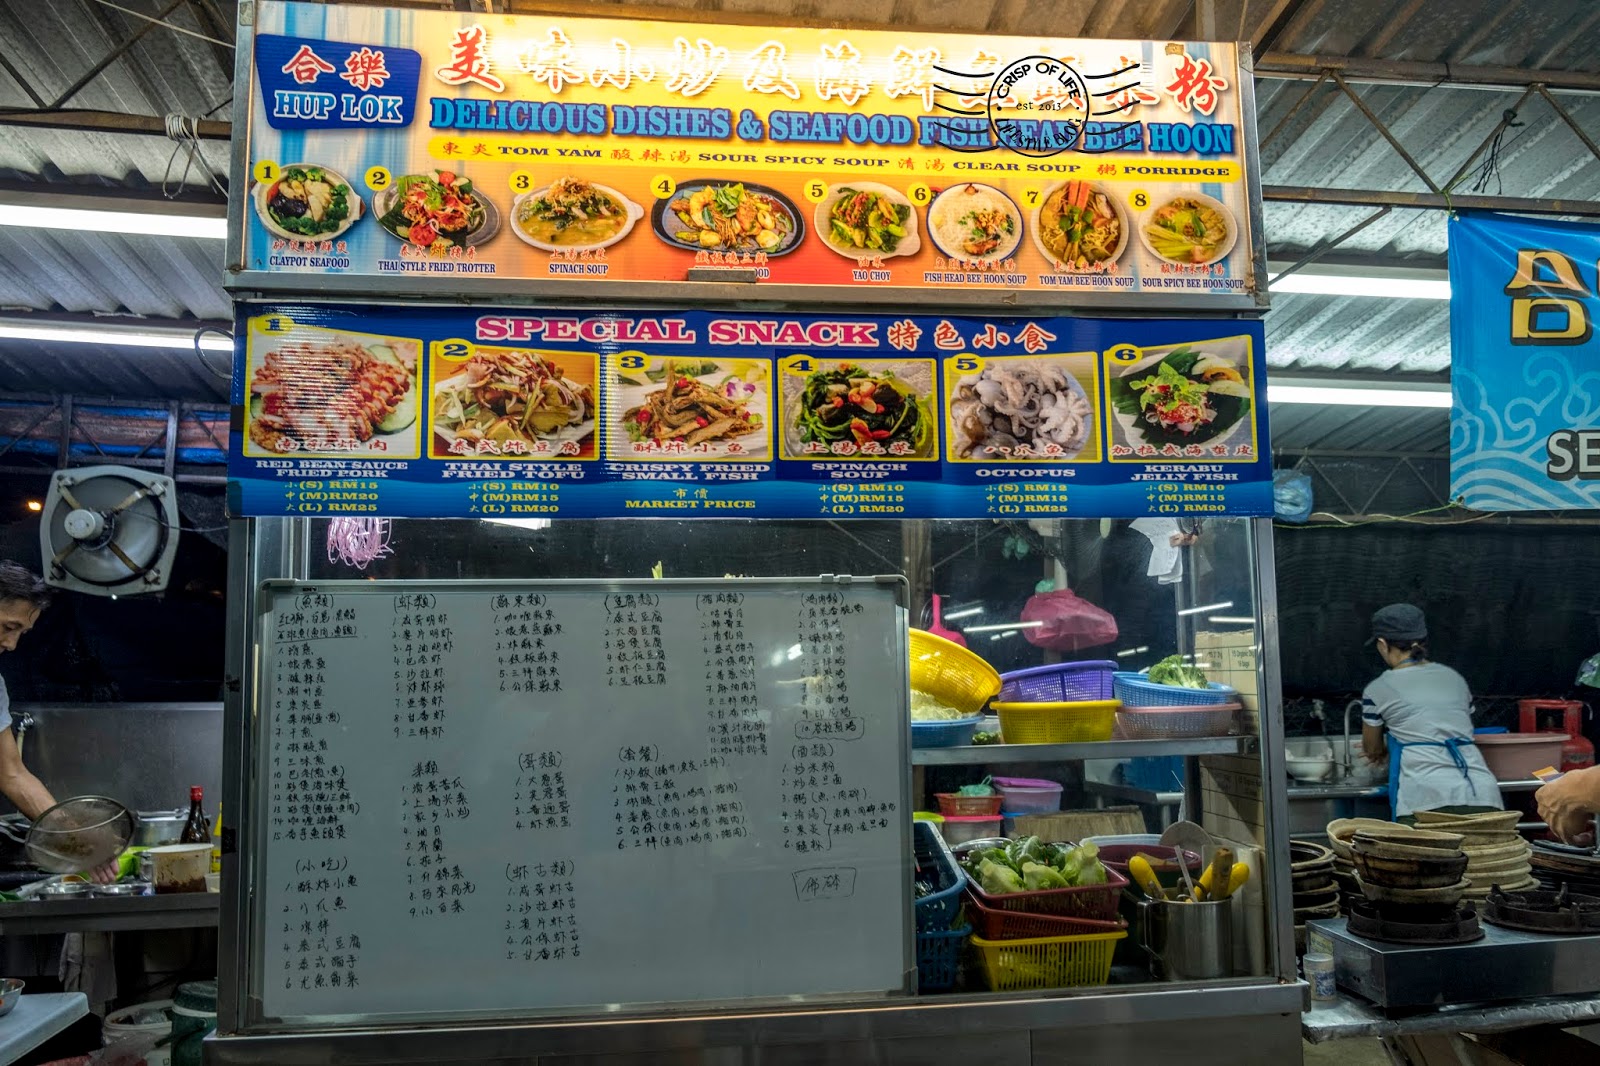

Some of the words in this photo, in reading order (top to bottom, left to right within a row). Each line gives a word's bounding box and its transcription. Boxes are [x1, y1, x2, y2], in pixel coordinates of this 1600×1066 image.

[283, 45, 391, 90] 合樂
[274, 91, 335, 119] HUP
[340, 94, 403, 123] LOK
[430, 97, 606, 134] DELICIOUS
[612, 104, 731, 139] DISHES
[736, 109, 761, 138] &
[770, 110, 915, 145] SEAFOOD
[920, 115, 990, 148] FISH
[1083, 121, 1144, 151] BEE
[1148, 122, 1234, 154] HOON
[498, 146, 549, 156] TOM
[556, 148, 602, 158] YAM
[699, 153, 758, 163] SOUR
[765, 155, 827, 165] SPICY
[833, 157, 890, 167] SOUP
[263, 166, 273, 179] 1
[953, 161, 1020, 171] CLEAR
[1027, 163, 1081, 173] SOUP
[1124, 166, 1230, 176] PORRIDGE
[373, 171, 386, 185] 2
[516, 175, 530, 188] 3
[657, 180, 671, 193] 4
[811, 184, 823, 197] 5
[914, 187, 927, 200] 6
[1027, 191, 1039, 203] 7
[1135, 194, 1146, 206] 8
[269, 255, 309, 267] CLAYPOT
[309, 257, 350, 268] SEAFOOD
[378, 261, 398, 271] THAI
[400, 262, 426, 272] STYLE
[428, 262, 454, 272] FRIED
[456, 263, 496, 274] TROTTER
[549, 264, 585, 274] SPINACH
[586, 265, 608, 275] SOUP
[853, 271, 868, 281] YAO
[870, 271, 891, 281] CHOY
[924, 272, 942, 282] FISH
[944, 273, 965, 283] HEAD
[966, 273, 982, 283] BEE
[984, 274, 1005, 284] HOON
[1006, 274, 1027, 284] SOUP
[1040, 277, 1056, 285] TOM
[1057, 277, 1074, 285] YAM
[1075, 277, 1090, 286] BEE
[1092, 277, 1114, 286] HOON
[1115, 277, 1134, 287] SOUP
[1142, 278, 1163, 287] SOUR
[1164, 279, 1185, 288] SPICY
[1186, 279, 1201, 288] BEE
[1202, 280, 1224, 289] HOON
[1225, 280, 1244, 289] SOUP
[265, 319, 285, 332] 1
[475, 316, 695, 344] SPECIAL
[709, 319, 879, 346] SNACK
[887, 319, 1057, 354] 特色小食
[442, 344, 469, 357] 2
[1115, 349, 1137, 361] 6
[621, 355, 644, 368] 3
[788, 360, 813, 372] 4
[956, 358, 978, 370] 5
[256, 460, 294, 468] RED
[299, 460, 345, 469] BEAN
[351, 461, 408, 470] SAUCE
[445, 462, 502, 471] THAI
[509, 463, 582, 471] STYLE
[609, 464, 694, 472] CRISPY
[701, 464, 770, 472] FRIED
[811, 463, 908, 471] SPINACH
[276, 469, 334, 477] FRIED
[338, 469, 388, 478] PORK
[442, 470, 515, 478] FRIED
[522, 471, 585, 479] TOFU
[622, 472, 699, 480] SMALL
[830, 471, 890, 479] SOUP
[975, 468, 1076, 477] OCTOPUS
[1131, 473, 1189, 481] JELLY
[1193, 473, 1238, 481] FISH
[329, 481, 378, 489] RM15
[859, 484, 905, 492] RM10
[1024, 484, 1068, 492] RM12
[1183, 484, 1225, 492] RM10
[328, 504, 377, 512] RM25
[625, 500, 699, 508] MARKET
[703, 500, 756, 508] PRICE
[859, 505, 905, 513] RM20
[1183, 504, 1226, 512] RM20
